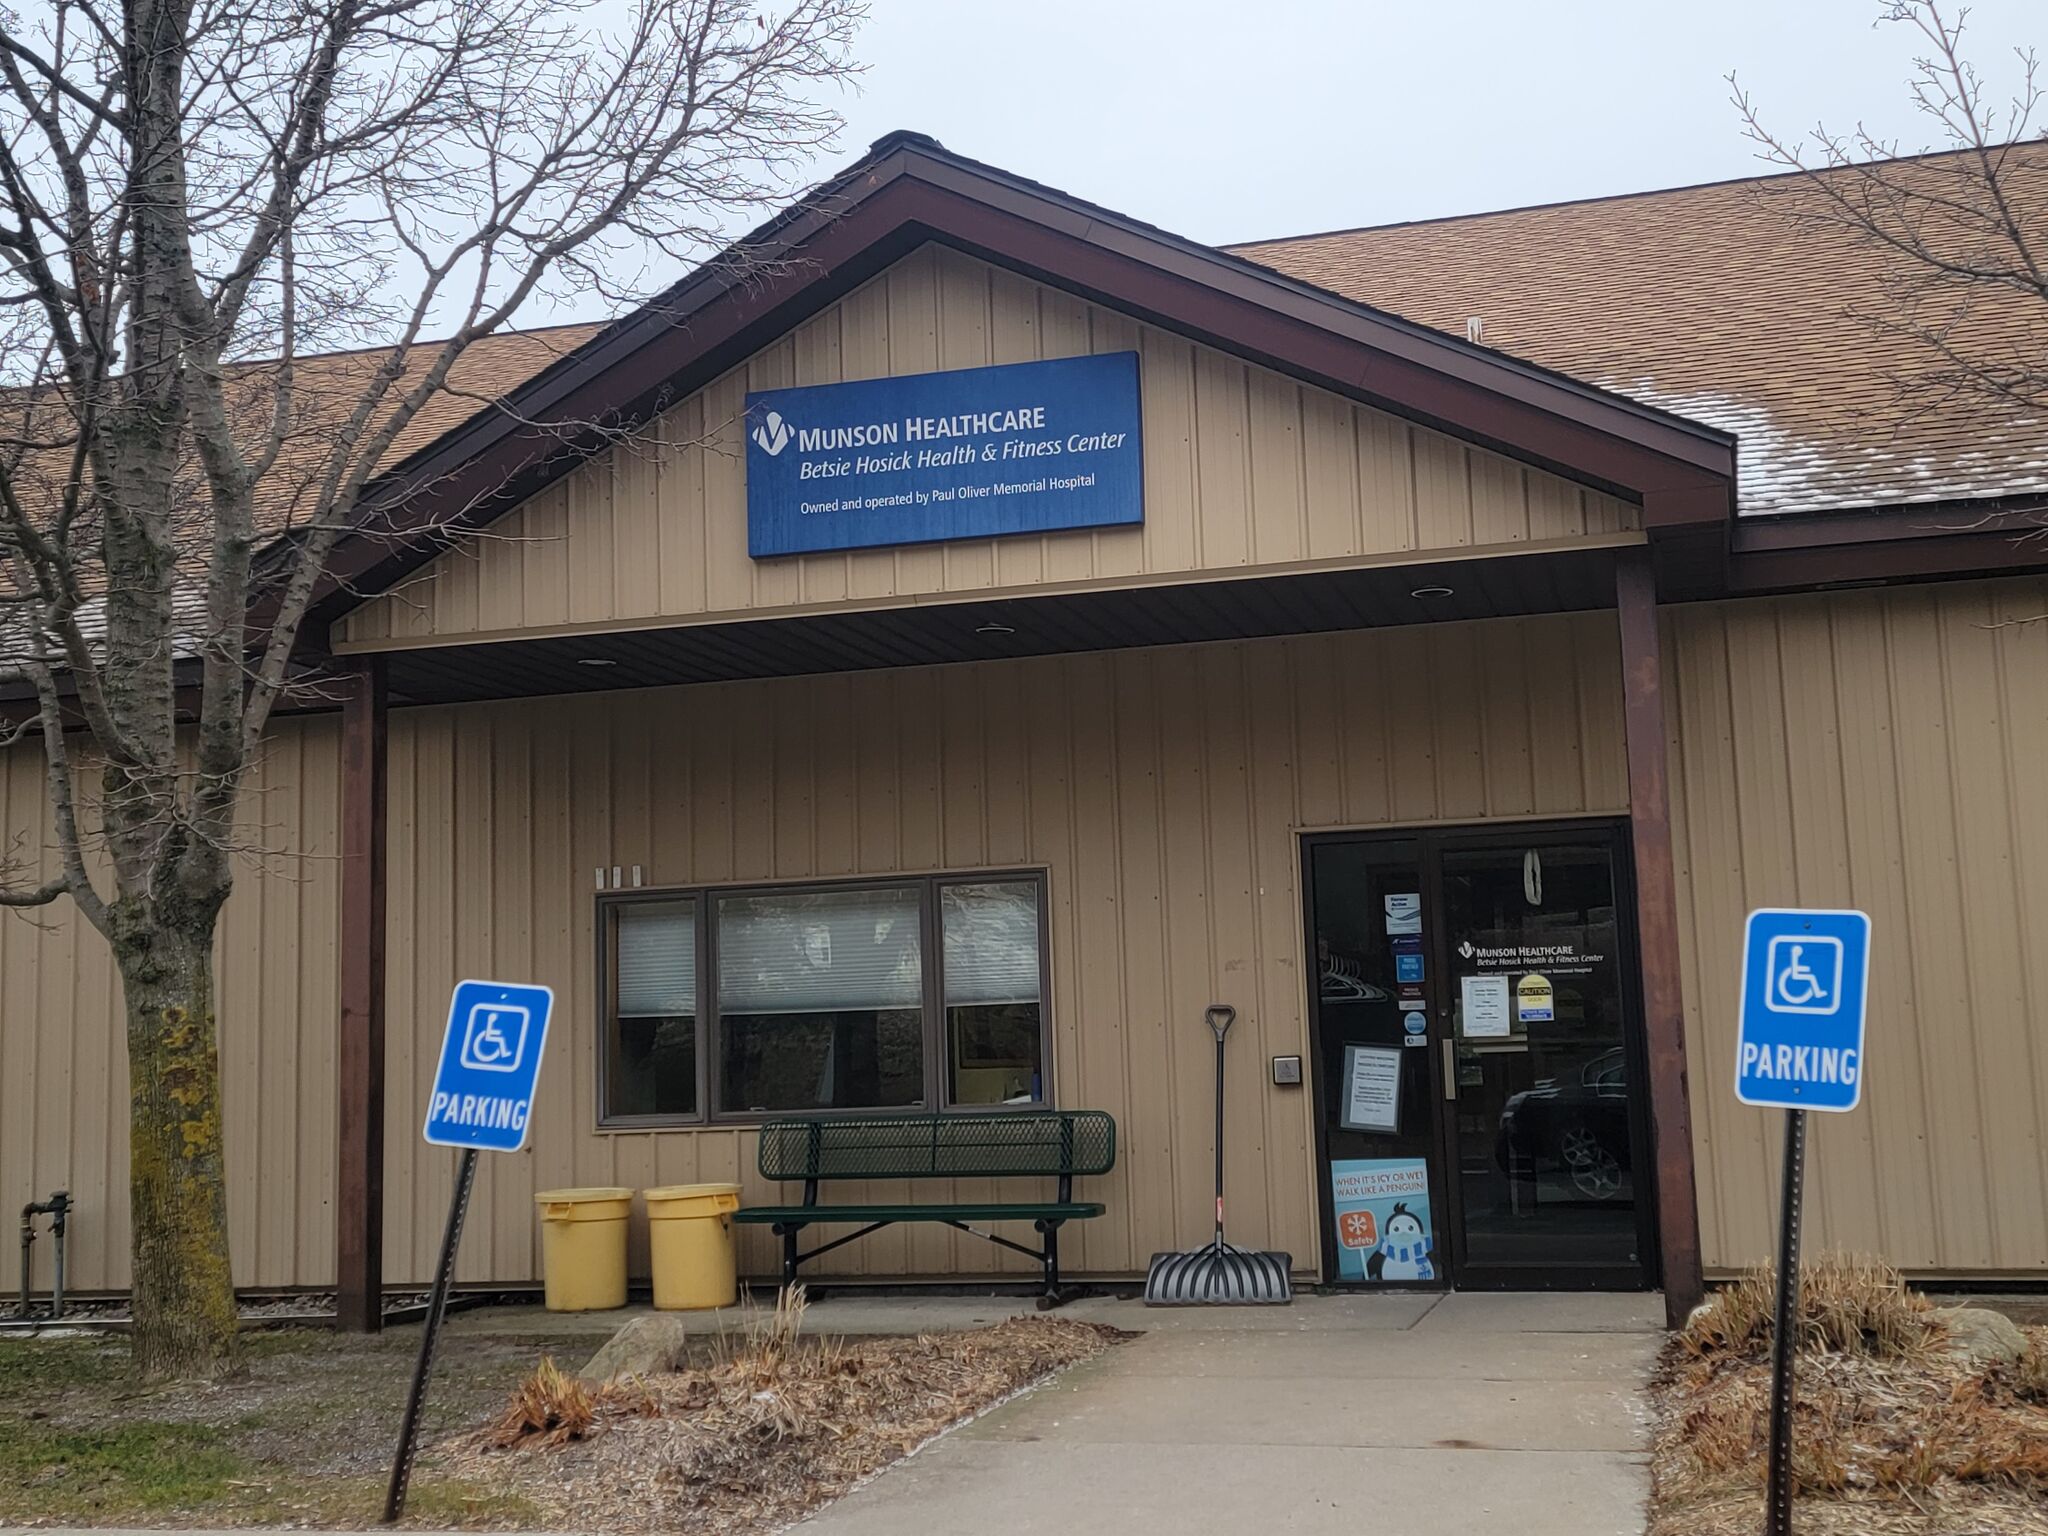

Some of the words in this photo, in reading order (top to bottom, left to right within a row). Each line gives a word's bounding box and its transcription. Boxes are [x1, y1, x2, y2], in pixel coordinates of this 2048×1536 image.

[799, 422, 898, 453] MUNSON
[906, 406, 1046, 442] HEALTHCARE
[800, 457, 851, 480] Betsie
[856, 450, 912, 475] Hosick
[917, 443, 976, 469] Health
[981, 443, 997, 462] &
[1002, 438, 1062, 460] Fitness
[1067, 432, 1126, 453] Center
[800, 498, 839, 515] Owned
[841, 496, 862, 511] and
[864, 491, 913, 510] operated
[916, 490, 930, 506] by
[932, 487, 955, 502] Paul
[958, 485, 991, 499] Oliver
[993, 479, 1046, 496] Memorial
[1049, 472, 1096, 492] Hospital
[1476, 947, 1516, 958] MUNSON
[1518, 945, 1574, 957] HEALTHCARE
[1477, 957, 1499, 966] Betsie
[1500, 956, 1522, 965] Hosick
[1523, 956, 1547, 965] Health
[1549, 956, 1555, 964] &
[1556, 955, 1580, 964] Fitness
[1581, 953, 1604, 962] Center
[1519, 987, 1551, 996] CAUTION
[1742, 1042, 1857, 1086] PARKING
[431, 1091, 528, 1132] PARKING
[1336, 1176, 1361, 1186] WHEN
[1377, 1174, 1390, 1183] ICY
[1392, 1172, 1404, 1182] OR
[1336, 1187, 1360, 1197] WALK
[1361, 1185, 1377, 1195] LIKE
[1378, 1184, 1386, 1193] A
[1347, 1236, 1373, 1246] Safety
